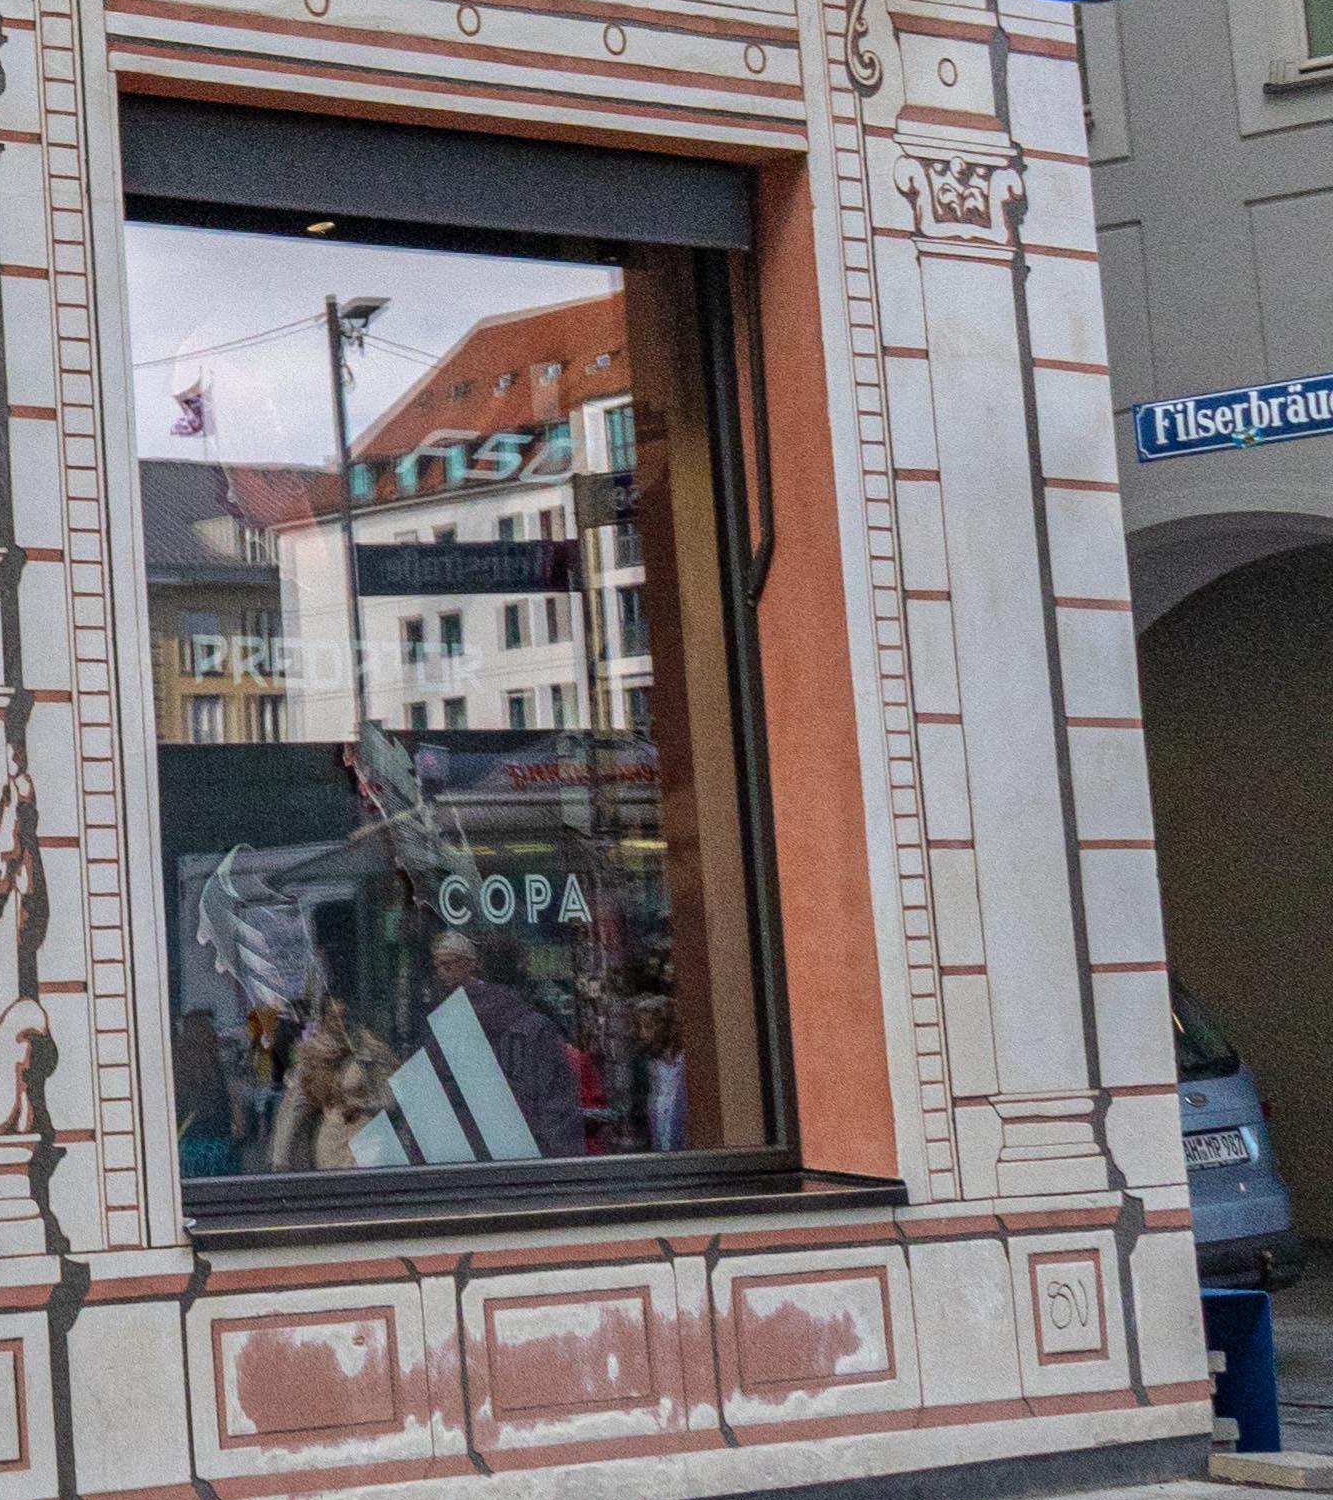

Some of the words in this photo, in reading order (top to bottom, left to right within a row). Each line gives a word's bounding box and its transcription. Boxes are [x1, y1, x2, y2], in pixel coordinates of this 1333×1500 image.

[1153, 383, 1333, 446] Filserbräu
[191, 633, 489, 695] PREDTOR
[438, 873, 593, 926] COPA
